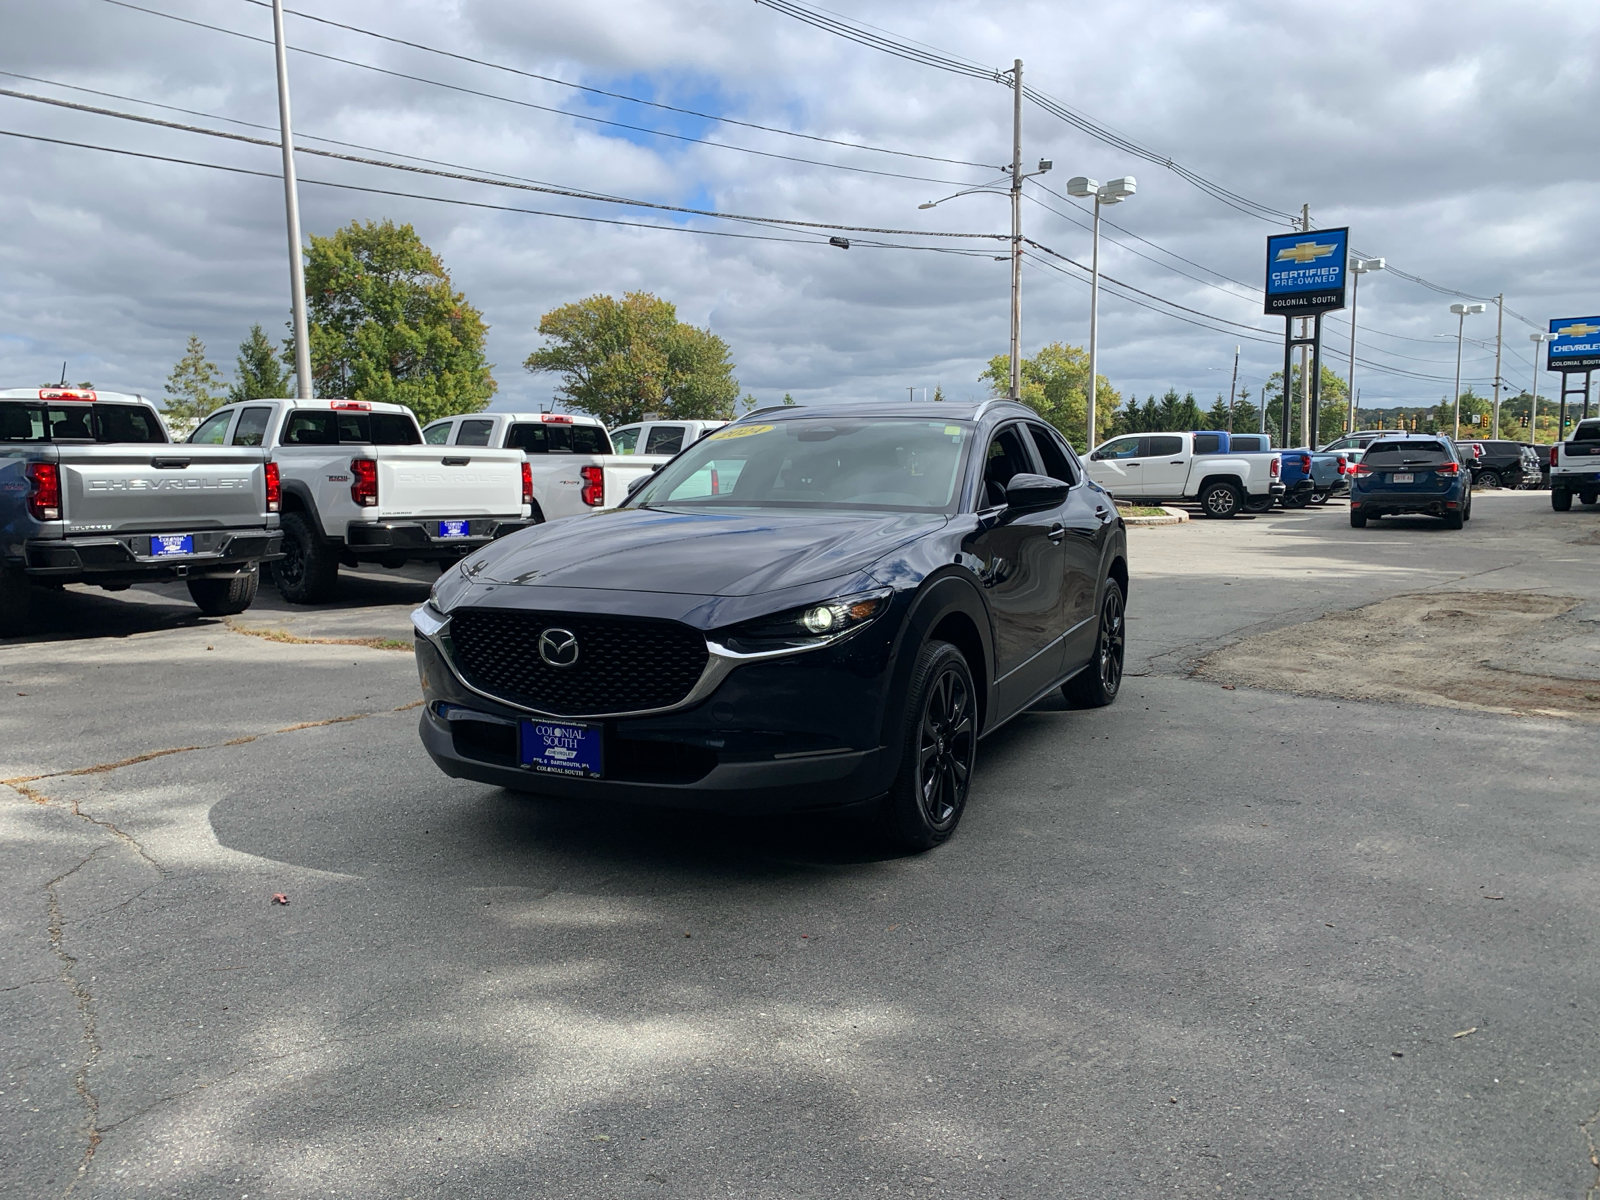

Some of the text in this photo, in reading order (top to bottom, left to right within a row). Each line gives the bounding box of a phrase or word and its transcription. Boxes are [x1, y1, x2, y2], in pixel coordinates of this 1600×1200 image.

[1272, 266, 1340, 280] CERTIFIED
[1275, 274, 1336, 287] PRE-OWNED
[1272, 295, 1337, 307] COLONIAL SOUTH
[88, 477, 249, 491] CHEVROLET
[397, 473, 511, 484] CHEVROLET
[536, 725, 586, 740] COLONIAL
[543, 736, 578, 748] SOUTH
[547, 749, 575, 757] CHEVROLET
[550, 759, 581, 769] DARTMOUTH,
[536, 765, 584, 776] COLONIAL SOUTH
